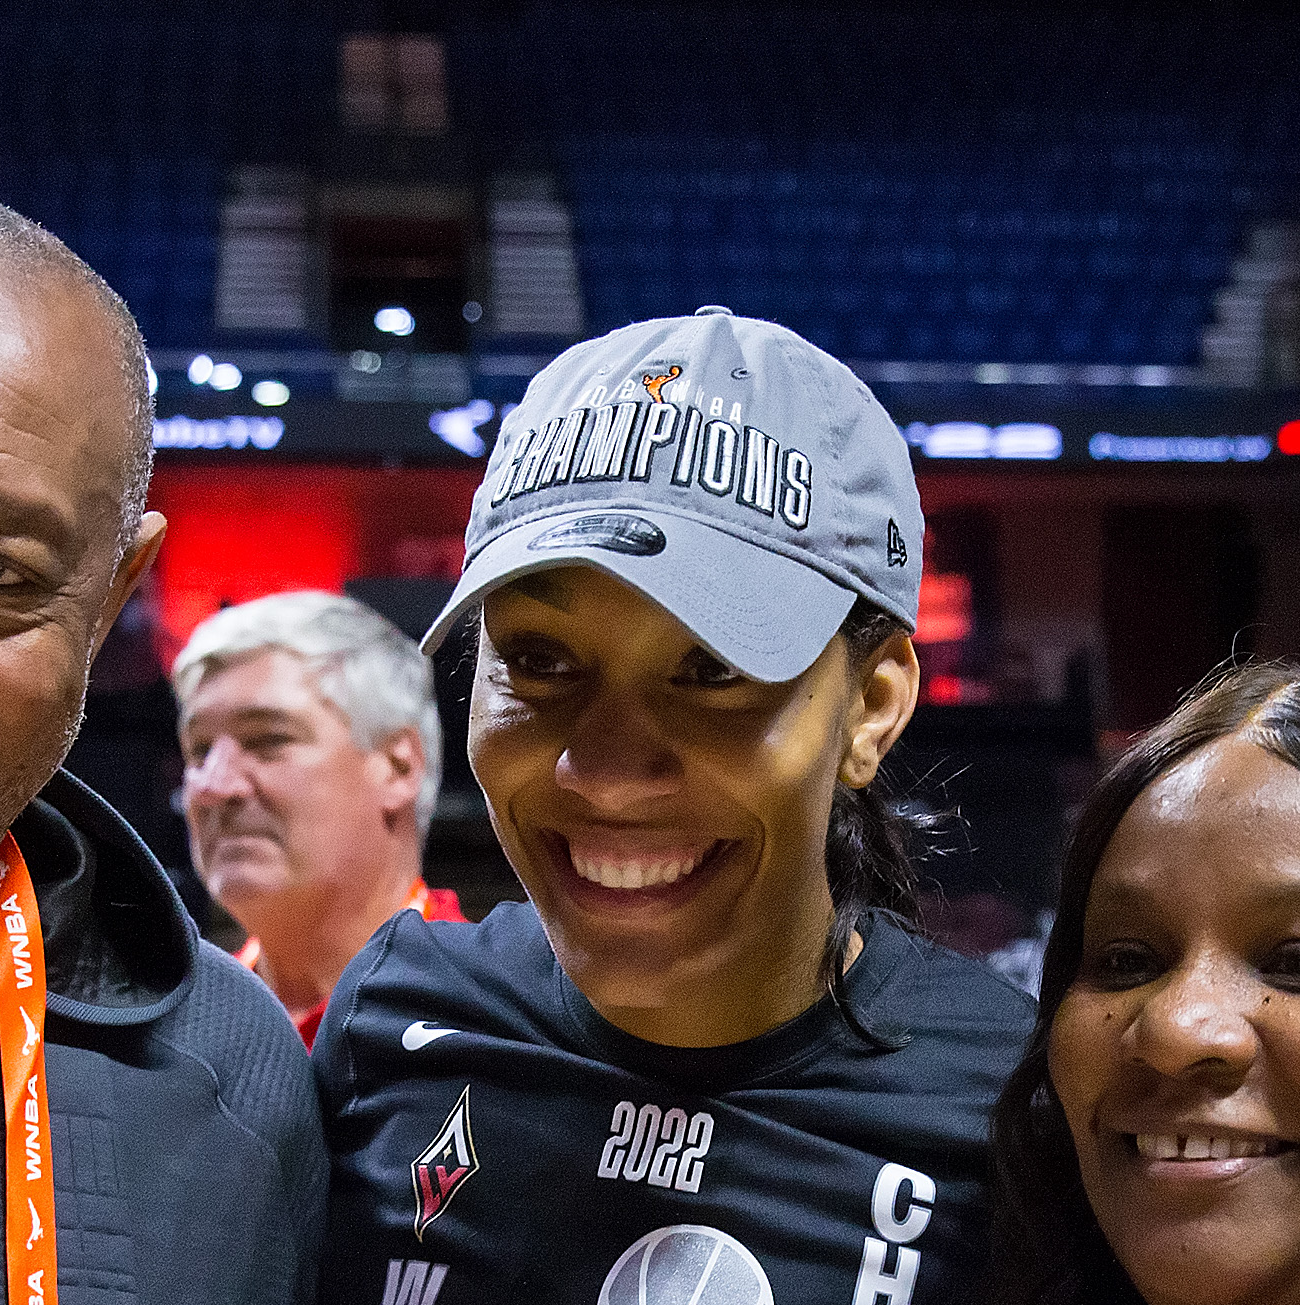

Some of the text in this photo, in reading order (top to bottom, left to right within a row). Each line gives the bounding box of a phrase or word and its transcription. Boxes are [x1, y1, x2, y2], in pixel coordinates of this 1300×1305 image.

[490, 400, 814, 531] CHAMPIONS
[3, 892, 32, 990] WNBA
[25, 1073, 44, 1183] WNBA
[596, 1099, 715, 1194] 2022
